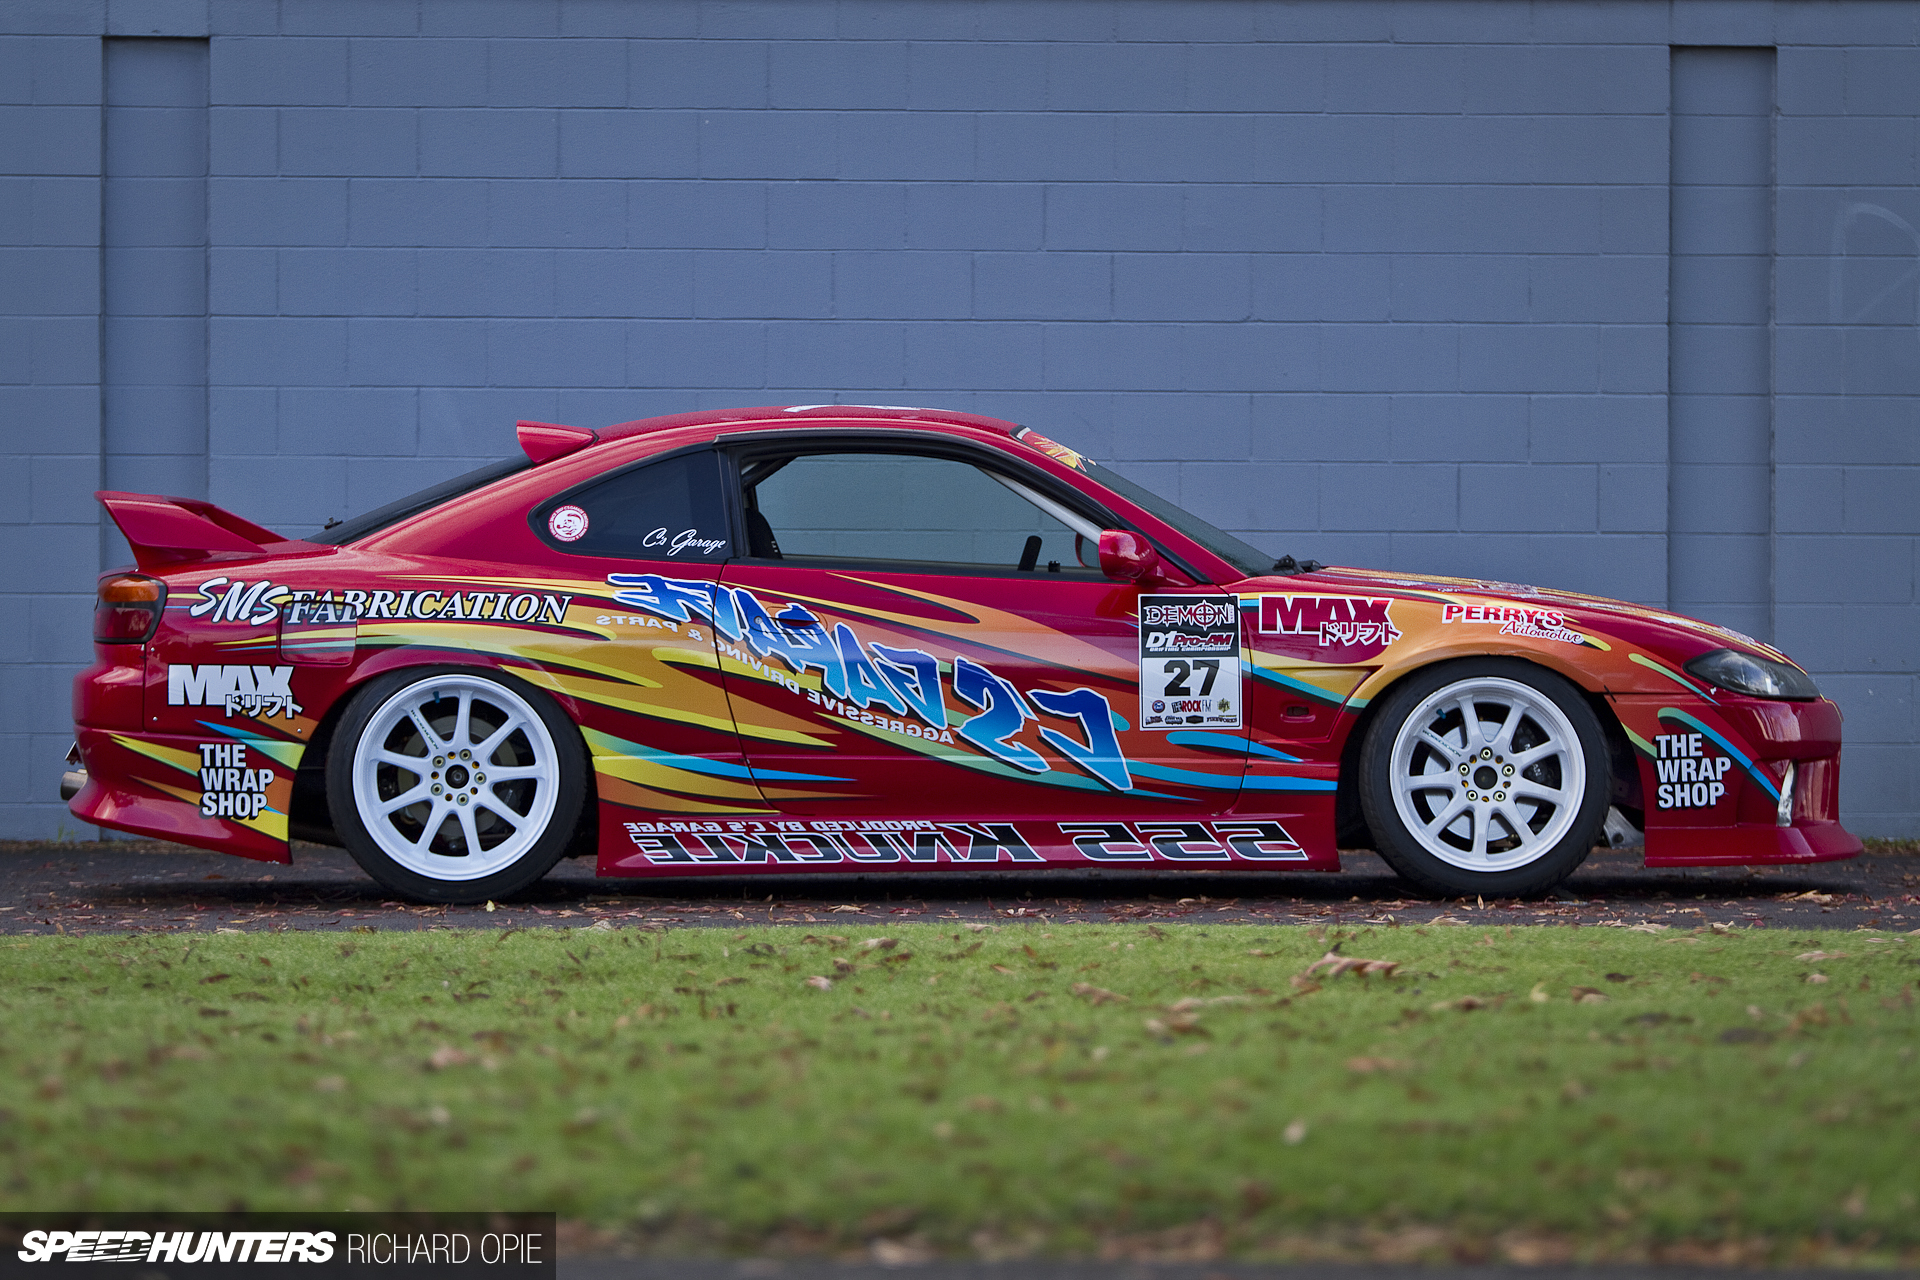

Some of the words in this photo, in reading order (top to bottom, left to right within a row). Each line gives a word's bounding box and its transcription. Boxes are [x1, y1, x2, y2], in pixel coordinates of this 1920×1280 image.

[666, 528, 727, 557] Garage
[190, 576, 290, 627] SMS
[286, 589, 573, 625] FABRICATION
[1143, 600, 1229, 631] DEMON
[1258, 595, 1397, 636] MAX
[1442, 602, 1565, 629] PERRY'S
[1318, 621, 1404, 647] ドリフト
[1499, 621, 1586, 645] Automotive
[167, 664, 295, 706] MAX
[1164, 659, 1220, 697] 27
[225, 693, 304, 719] ドリフト
[199, 743, 247, 768] THE
[1655, 733, 1704, 759] THE
[200, 767, 275, 793] WRAP
[1656, 756, 1732, 783] WRAP
[201, 791, 268, 817] SHOP
[1657, 782, 1725, 809] SHOP
